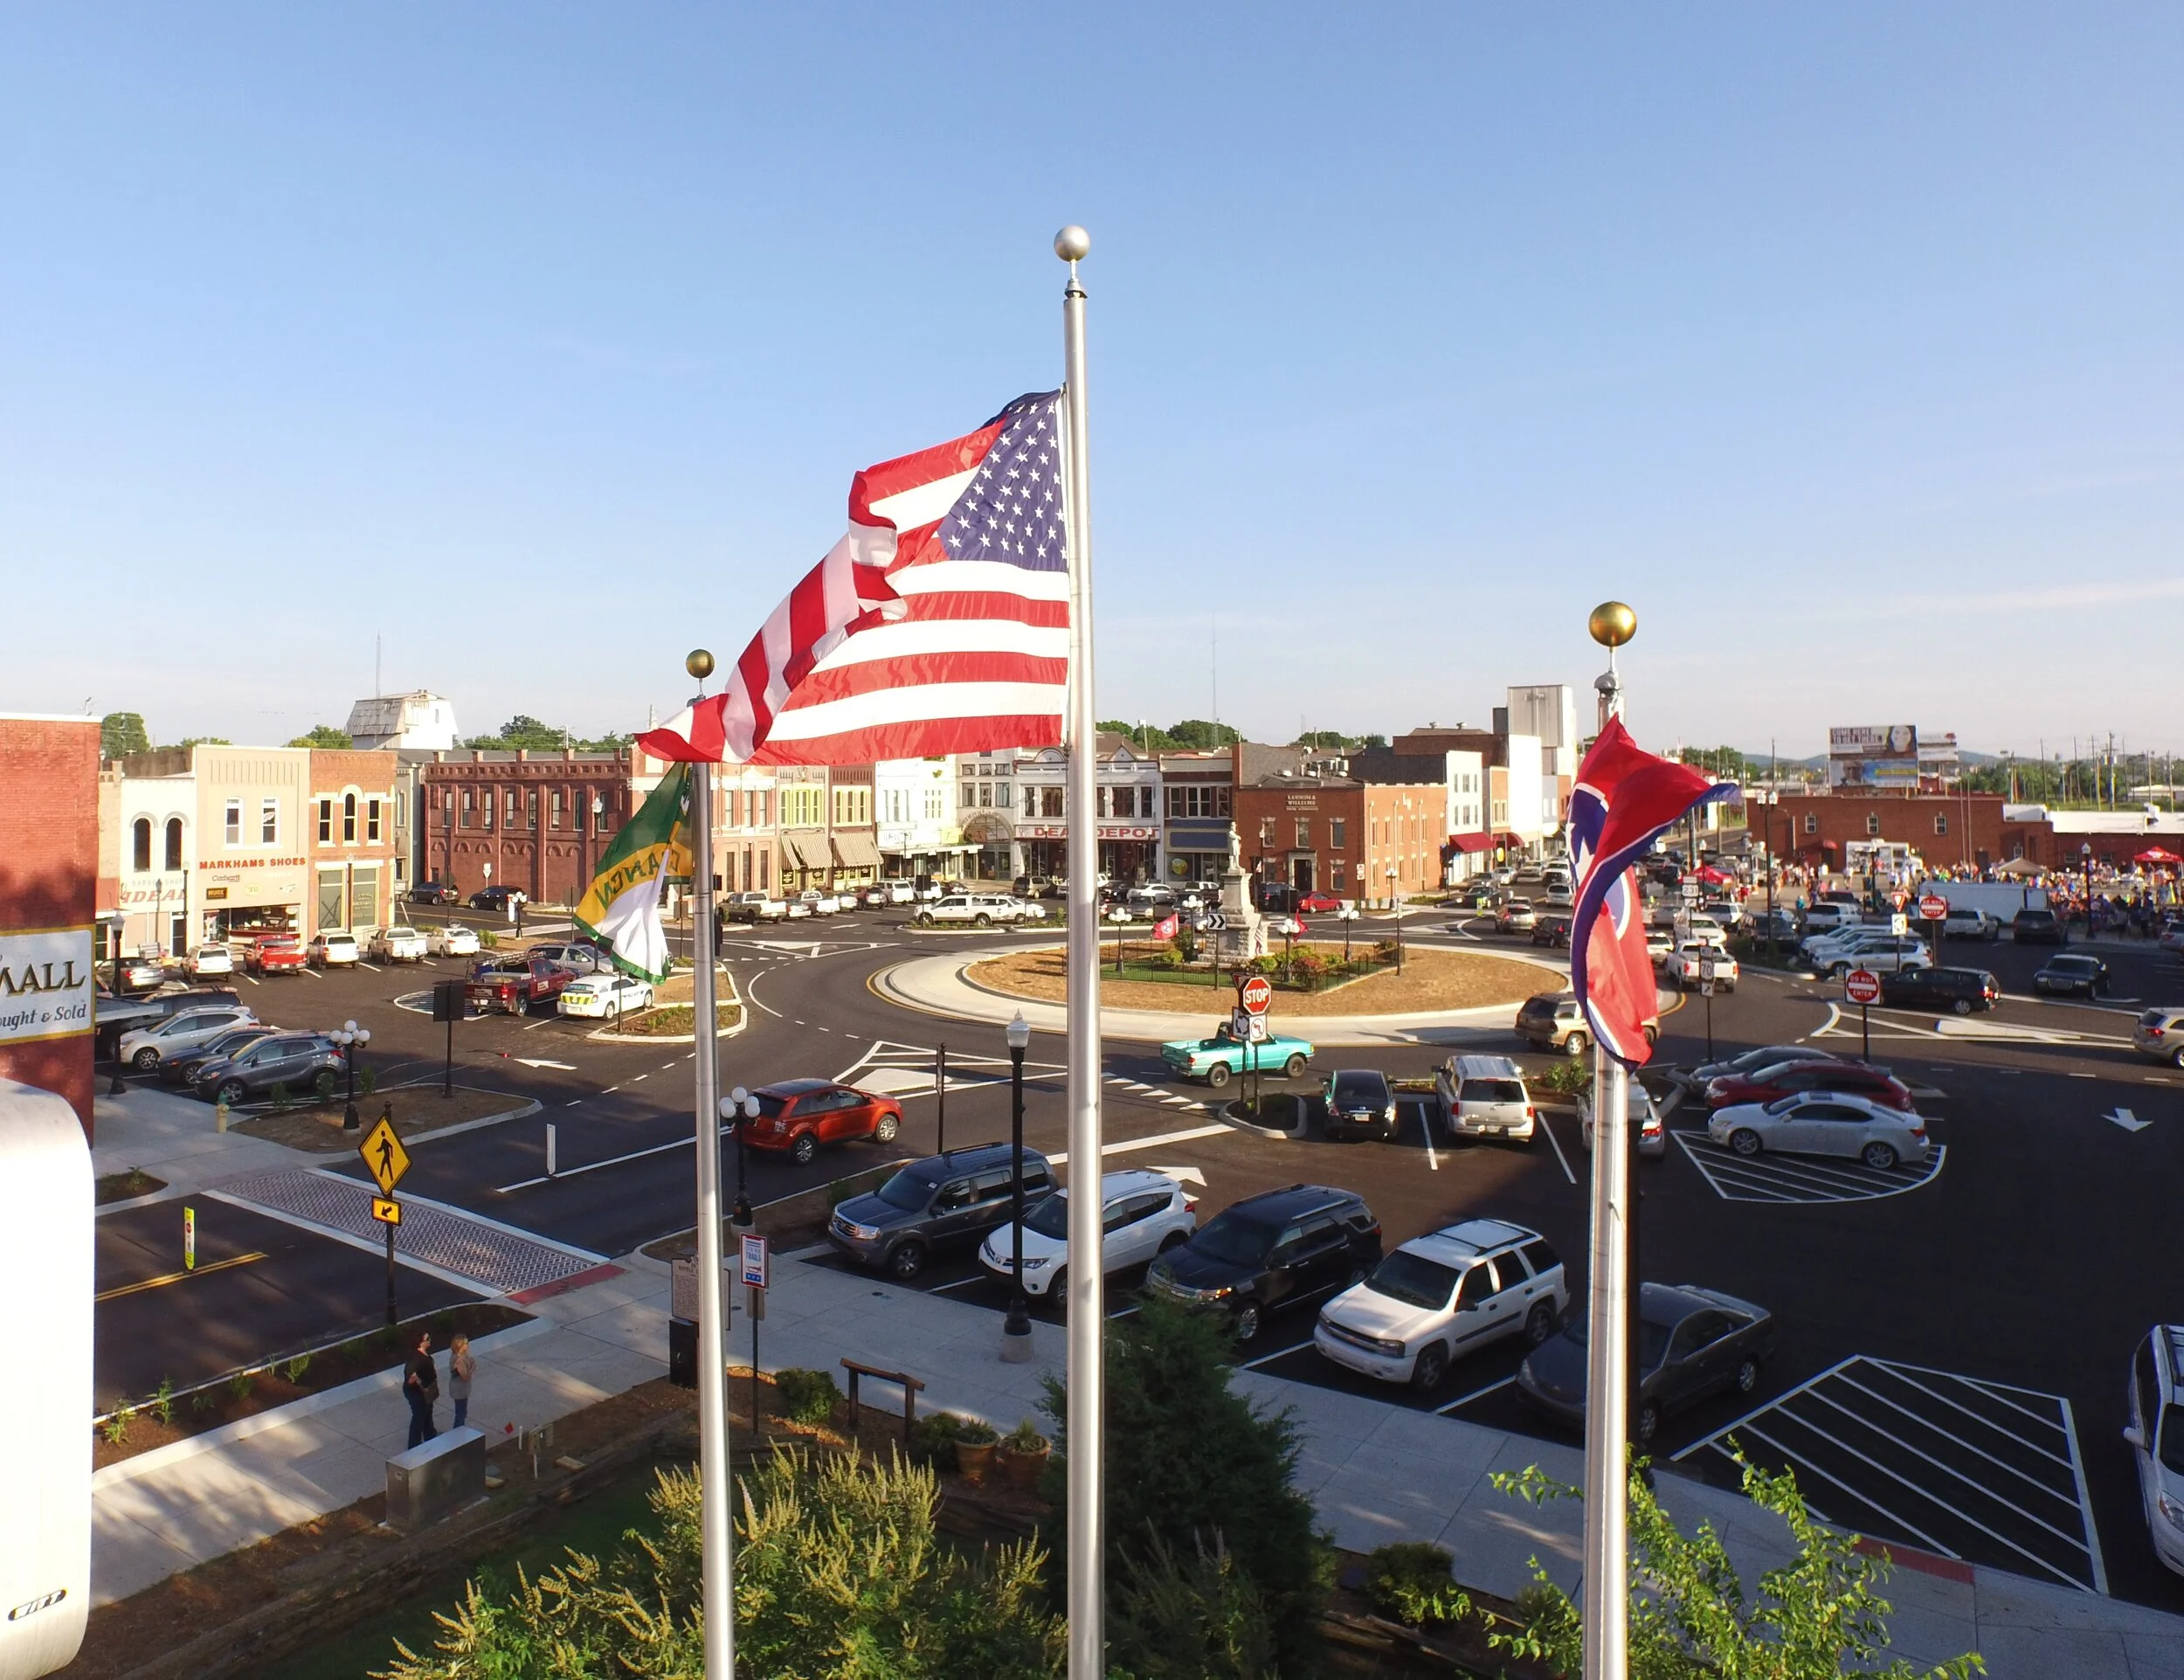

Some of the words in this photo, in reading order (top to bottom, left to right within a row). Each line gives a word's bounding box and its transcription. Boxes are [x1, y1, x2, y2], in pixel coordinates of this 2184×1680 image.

[1034, 827, 1068, 837] DEA
[199, 859, 265, 869] MARKHAMS
[270, 857, 306, 867] SHOES
[1702, 964, 1712, 977] 70
[1245, 987, 1268, 1004] STOP
[41, 1012, 52, 1023] &
[54, 1004, 86, 1021] Sold
[745, 1251, 761, 1262] TRAILS
